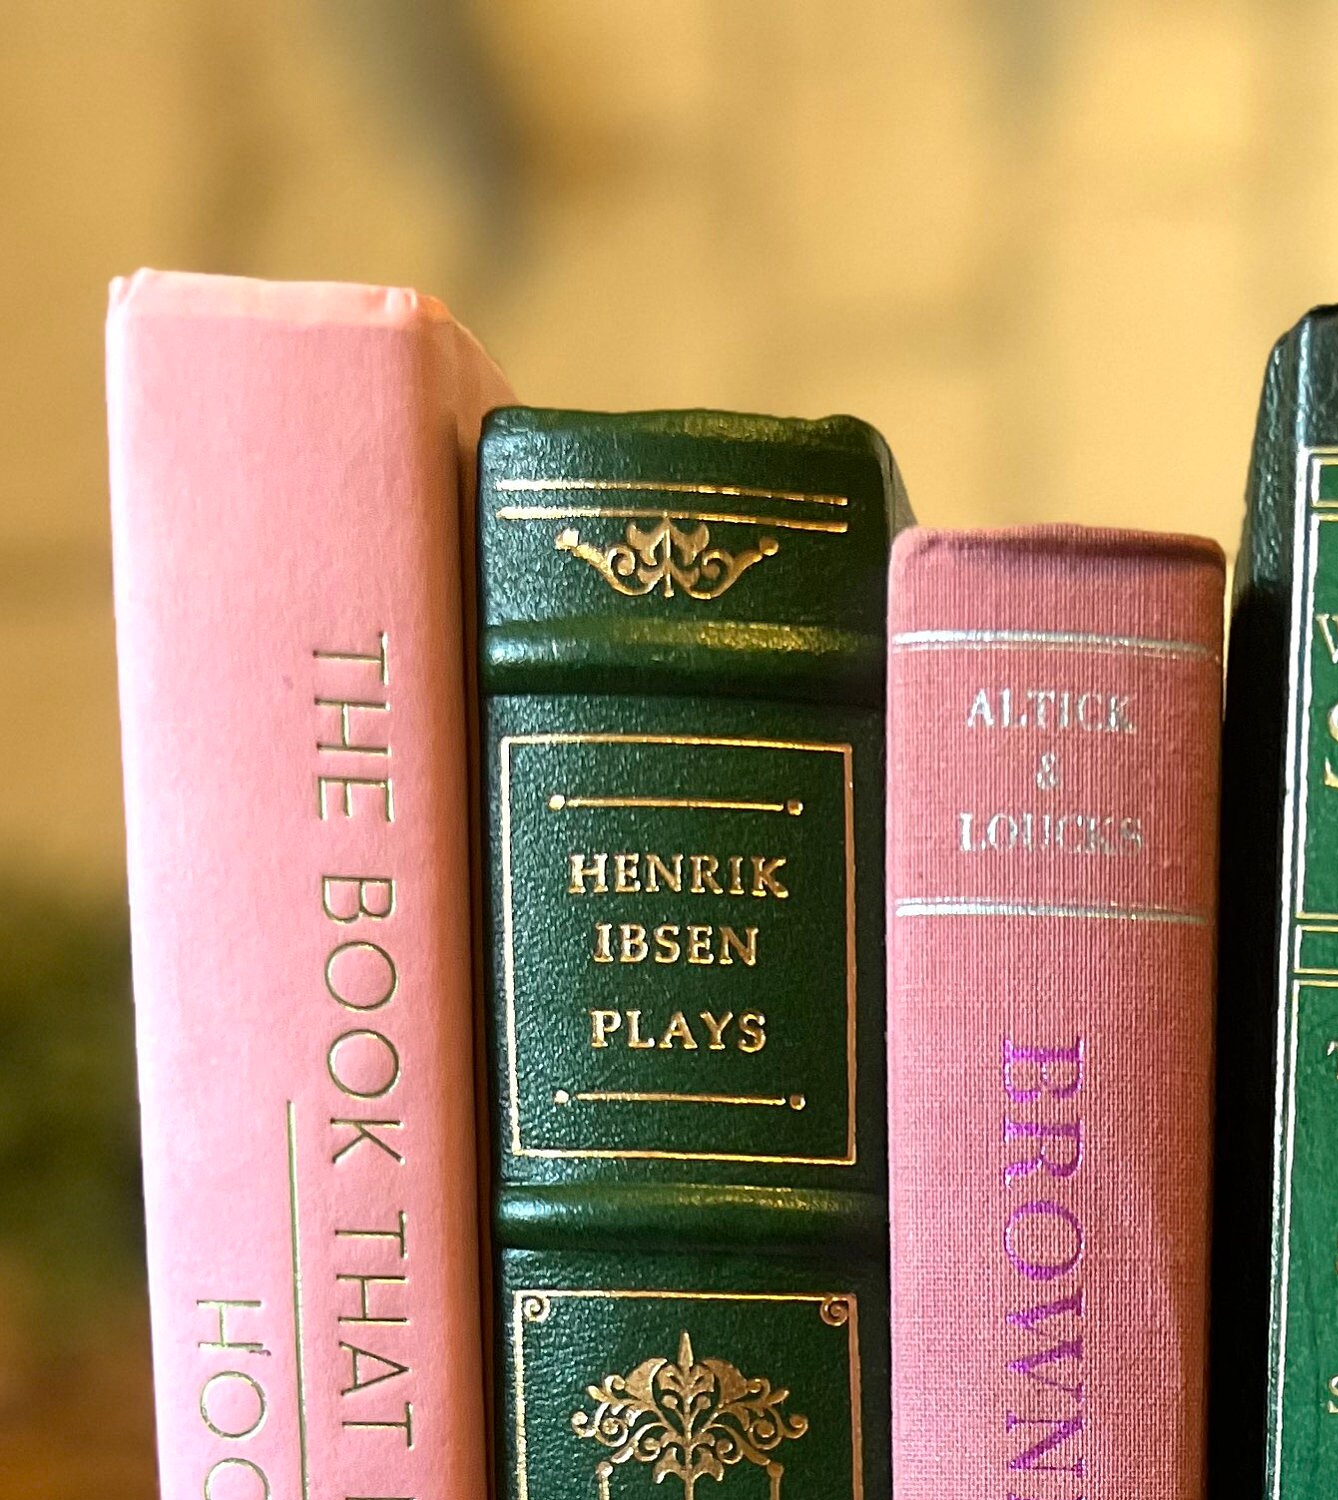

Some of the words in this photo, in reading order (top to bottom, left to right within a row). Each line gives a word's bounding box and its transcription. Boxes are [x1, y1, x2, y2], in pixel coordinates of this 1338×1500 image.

[311, 631, 395, 824] THE
[967, 688, 1138, 735] ALTICK
[1034, 752, 1063, 790] &
[958, 812, 1144, 856] LOUCKS
[567, 852, 789, 899] HENRIK
[593, 922, 759, 967] IBSEN
[320, 874, 408, 1167] BOOK
[589, 1009, 767, 1053] PLAYS
[333, 1210, 415, 1450] THAT
